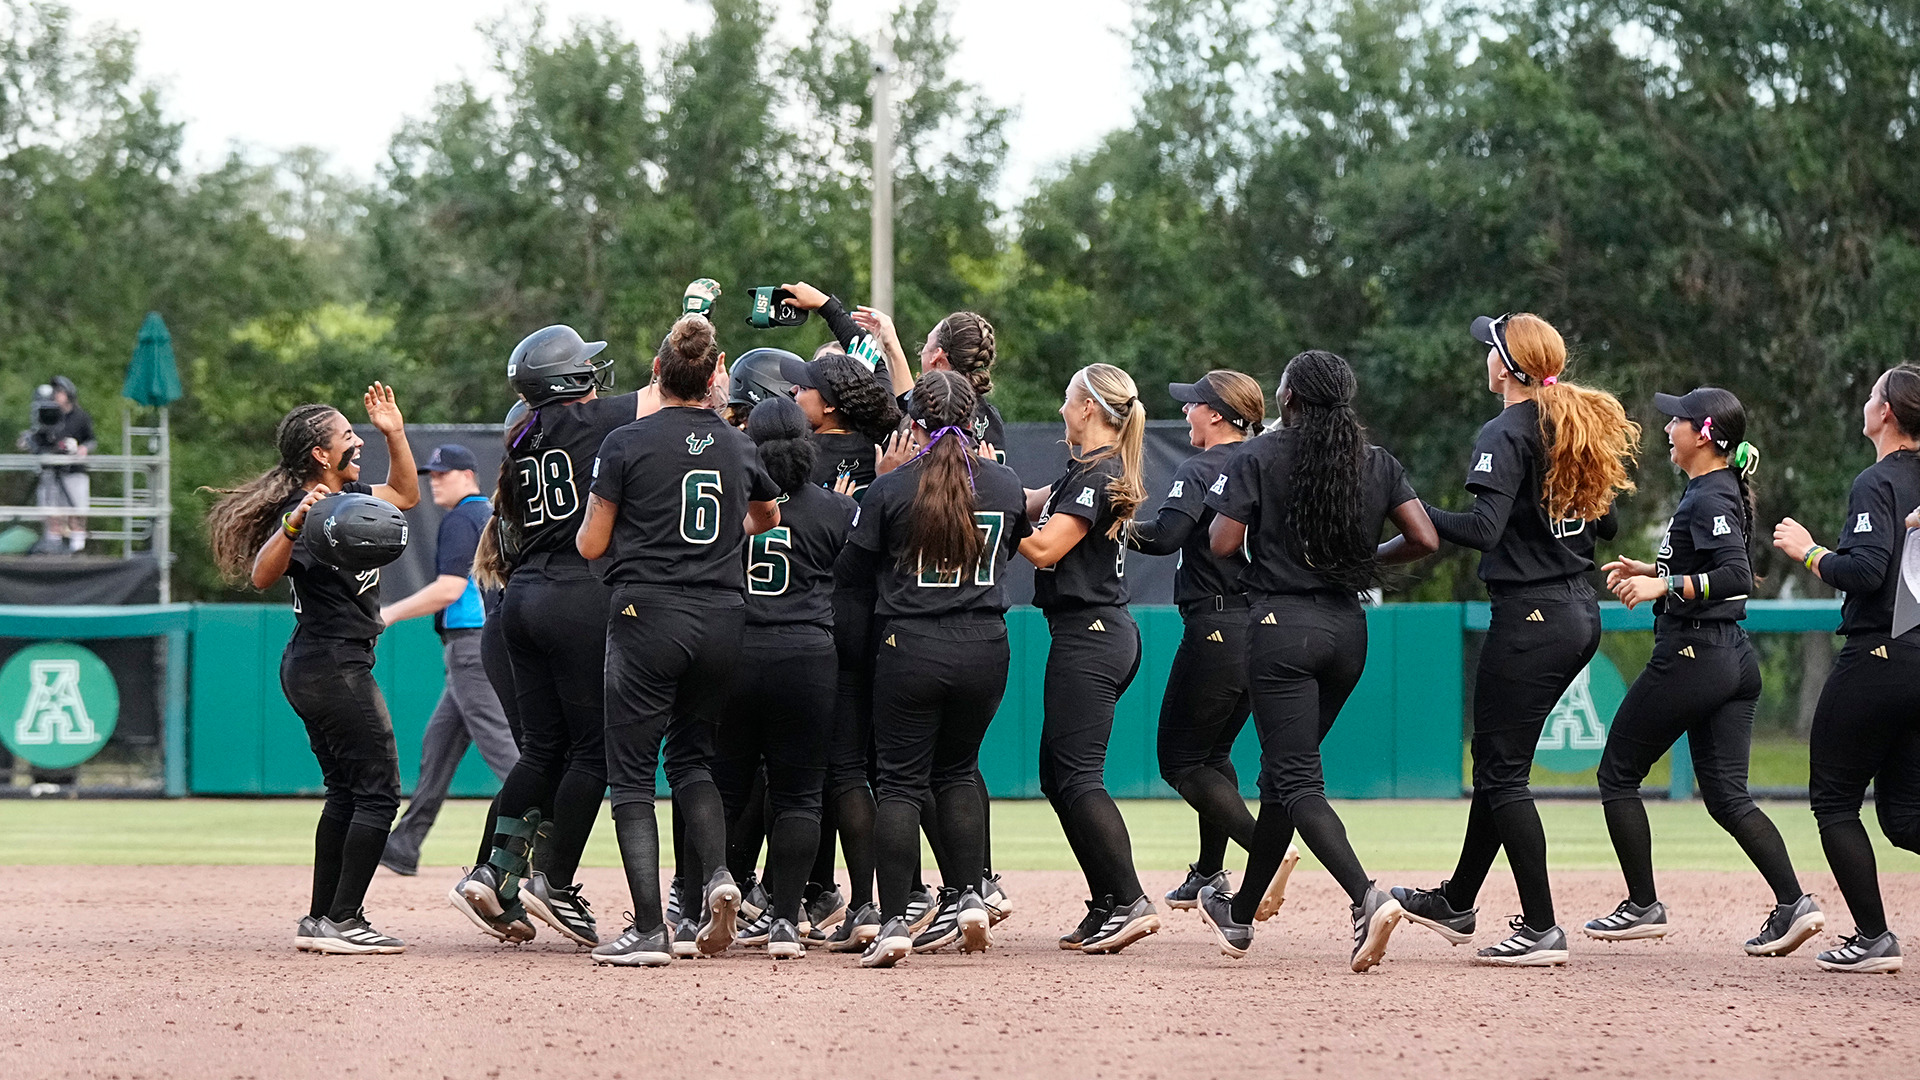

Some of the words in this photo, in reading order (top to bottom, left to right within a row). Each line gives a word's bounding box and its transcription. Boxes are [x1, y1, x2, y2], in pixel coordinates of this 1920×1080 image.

[755, 294, 769, 314] USF
[515, 449, 579, 528] 28
[680, 469, 723, 545] 6
[747, 526, 792, 596] 5
[14, 660, 95, 744] A
